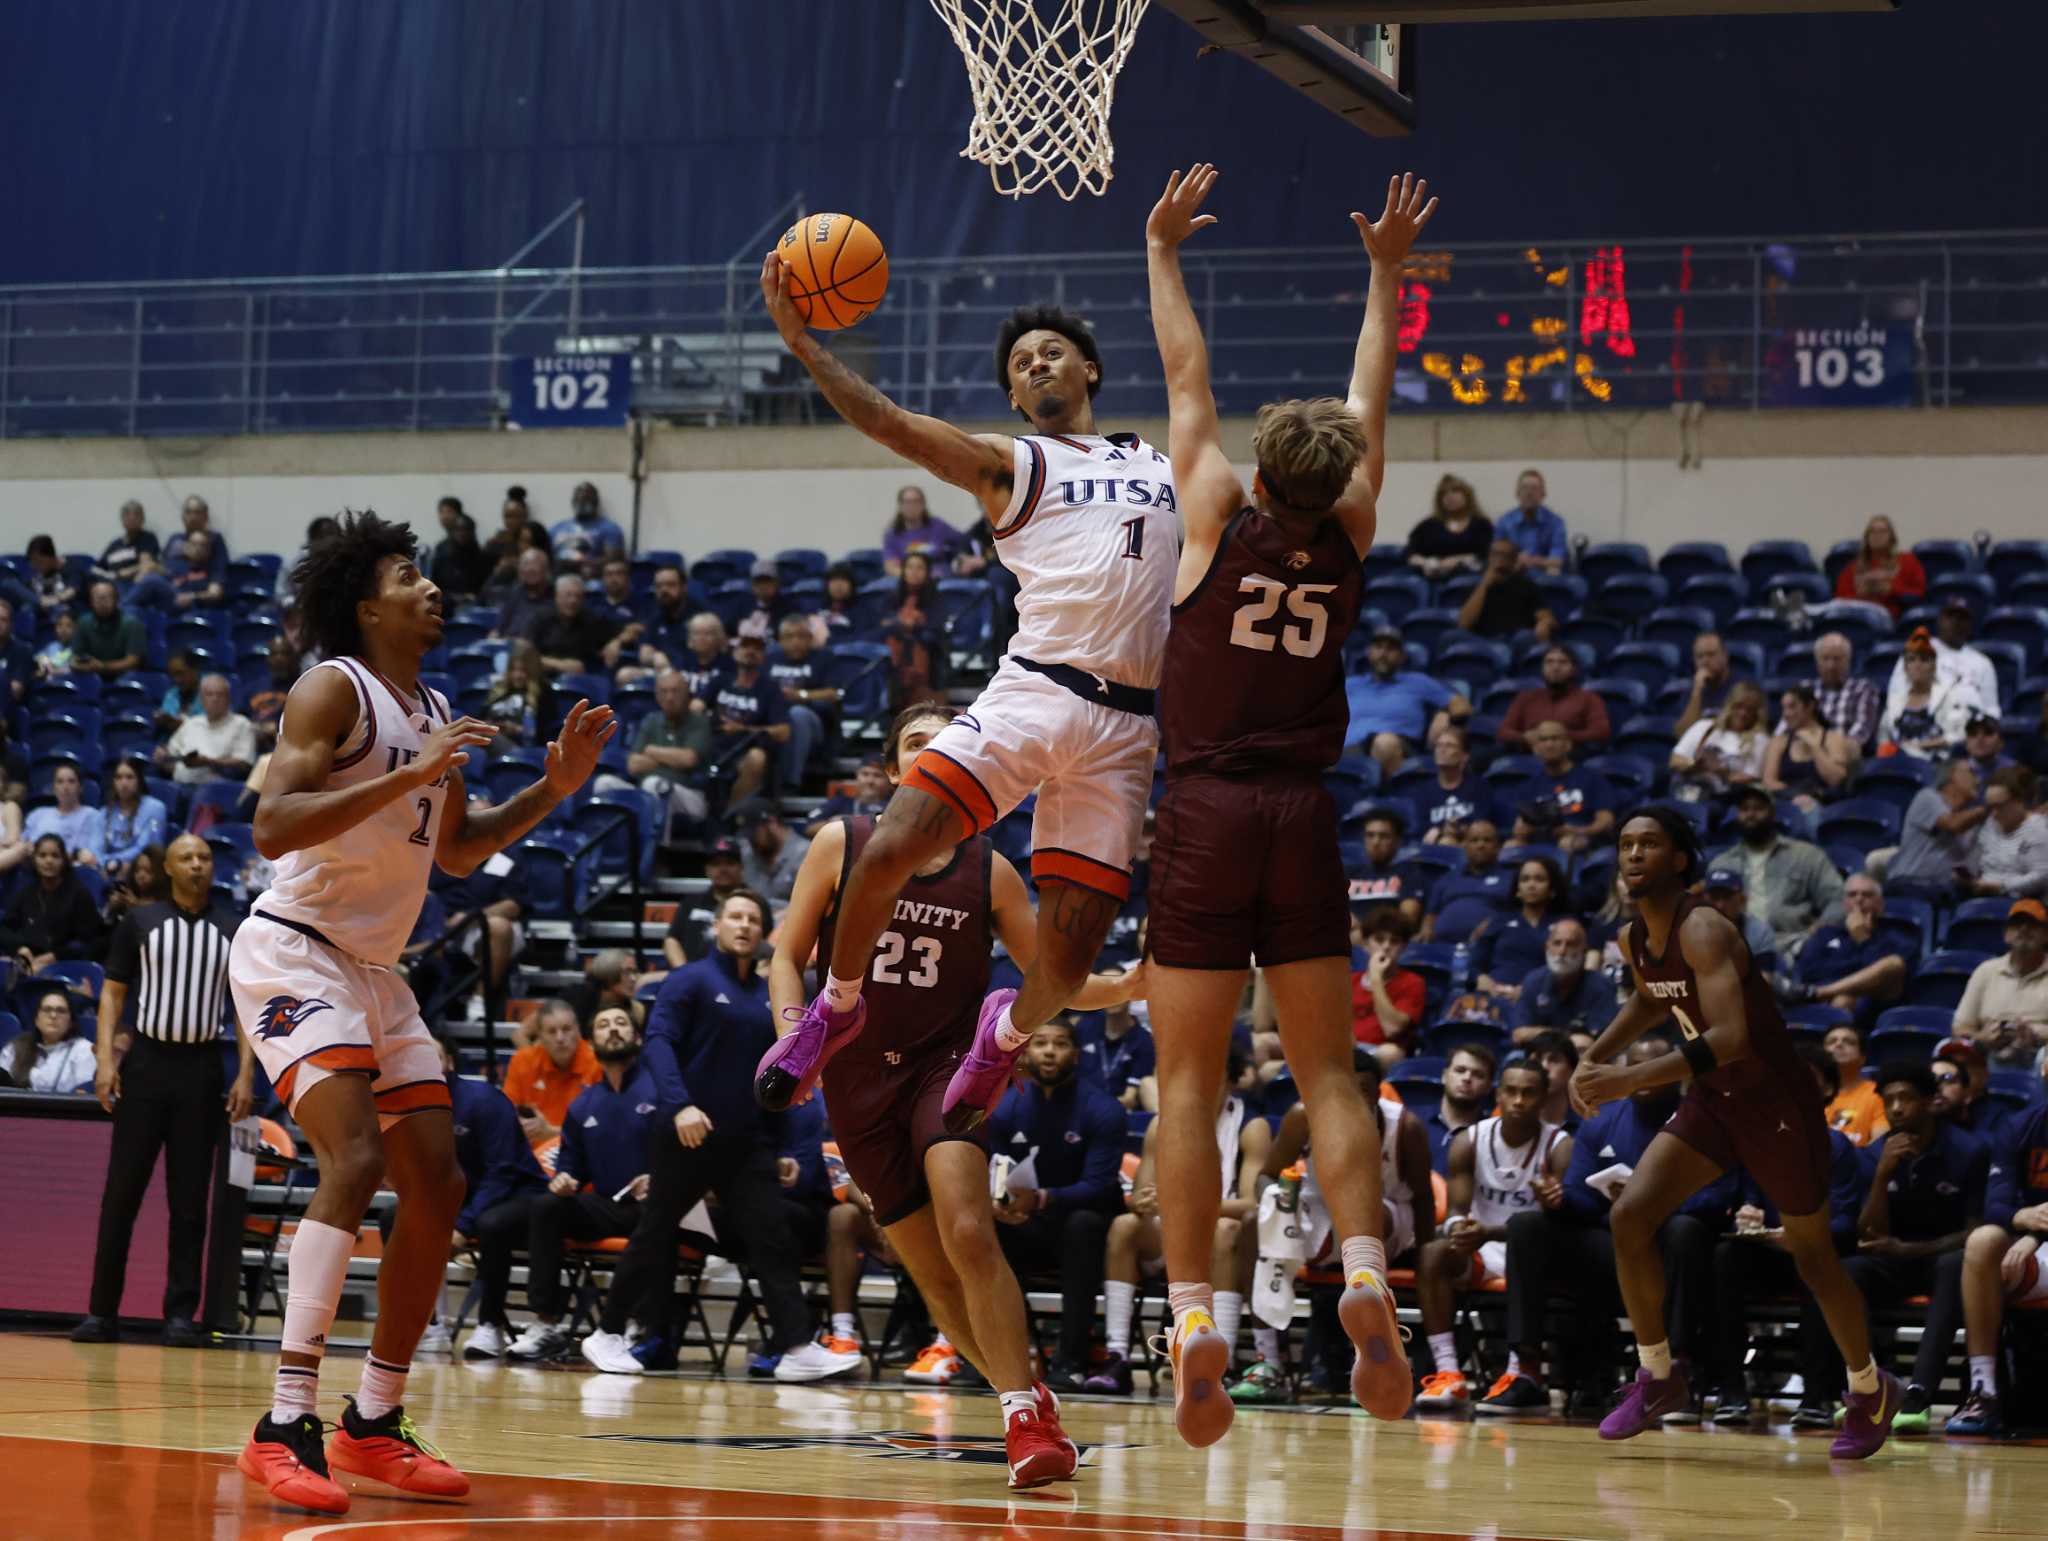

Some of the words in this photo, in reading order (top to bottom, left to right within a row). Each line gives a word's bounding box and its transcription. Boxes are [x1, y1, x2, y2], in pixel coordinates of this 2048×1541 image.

[1796, 328, 1887, 347] SECTION
[533, 357, 611, 373] SECTION
[1795, 348, 1885, 388] 103
[533, 373, 609, 409] 102
[1058, 478, 1177, 513] UTSA
[1121, 514, 1146, 561] 1
[1229, 572, 1338, 659] 25
[408, 797, 432, 847] 2
[893, 899, 970, 931] INITY
[872, 931, 943, 988] 23
